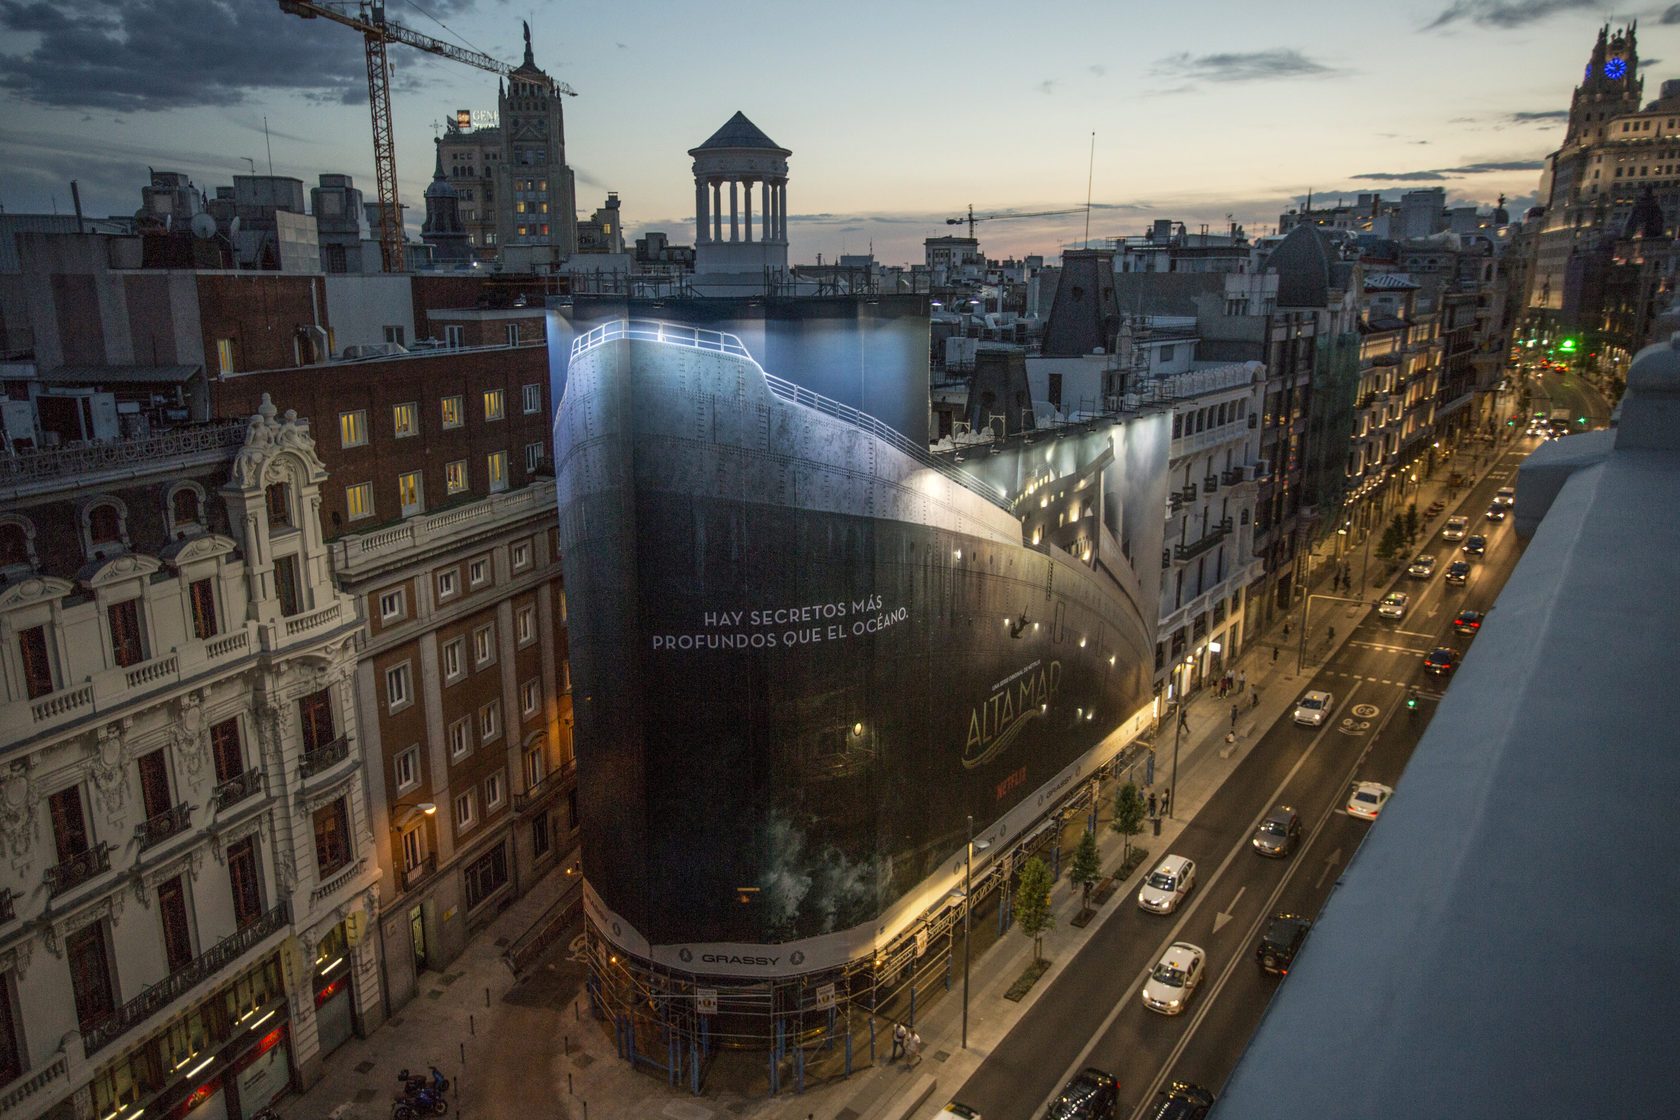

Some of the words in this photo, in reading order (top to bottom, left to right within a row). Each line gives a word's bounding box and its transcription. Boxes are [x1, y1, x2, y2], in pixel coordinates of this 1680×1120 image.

[704, 611, 743, 626] HAY
[750, 602, 846, 626] SECRETOS
[851, 593, 883, 614] MÁS
[652, 633, 777, 650] PROFUNDOS
[783, 628, 822, 647] QUE
[827, 625, 847, 640] EL
[852, 607, 909, 635] OCÉANO.
[702, 954, 780, 966] GRASSY
